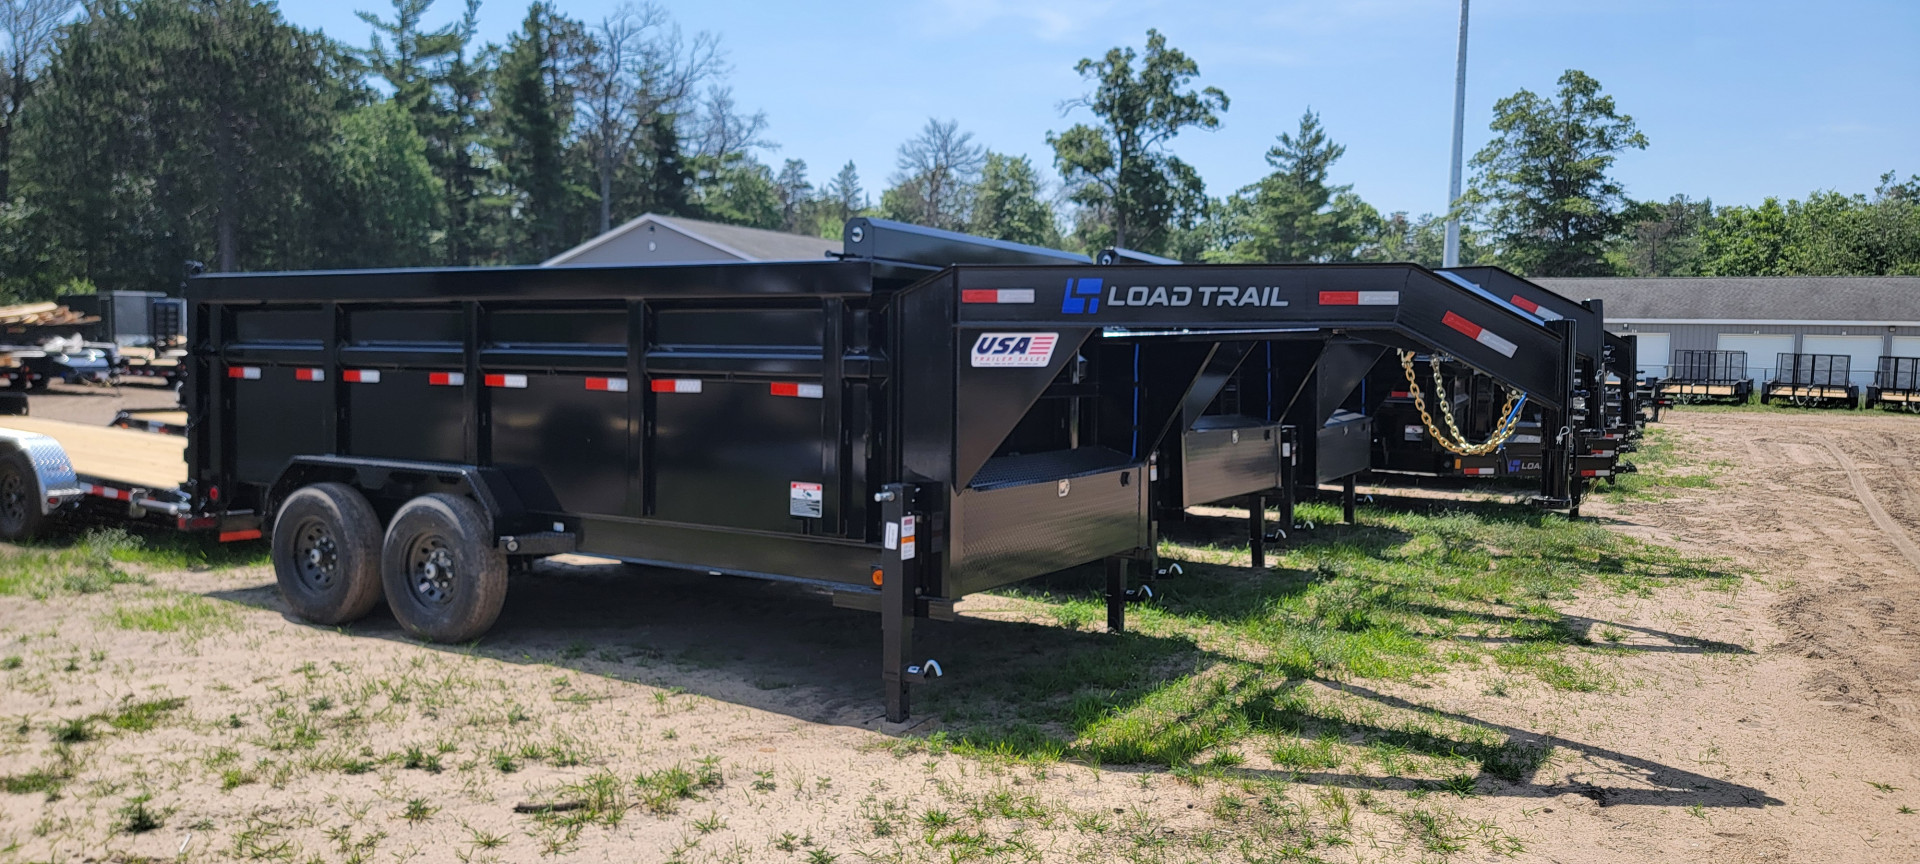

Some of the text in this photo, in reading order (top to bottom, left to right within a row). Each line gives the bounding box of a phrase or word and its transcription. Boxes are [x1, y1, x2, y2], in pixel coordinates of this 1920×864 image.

[1107, 286, 1193, 307] LOAD
[1198, 286, 1289, 307] TRAIL
[977, 337, 1032, 355] USA
[1521, 462, 1541, 470] LOA
